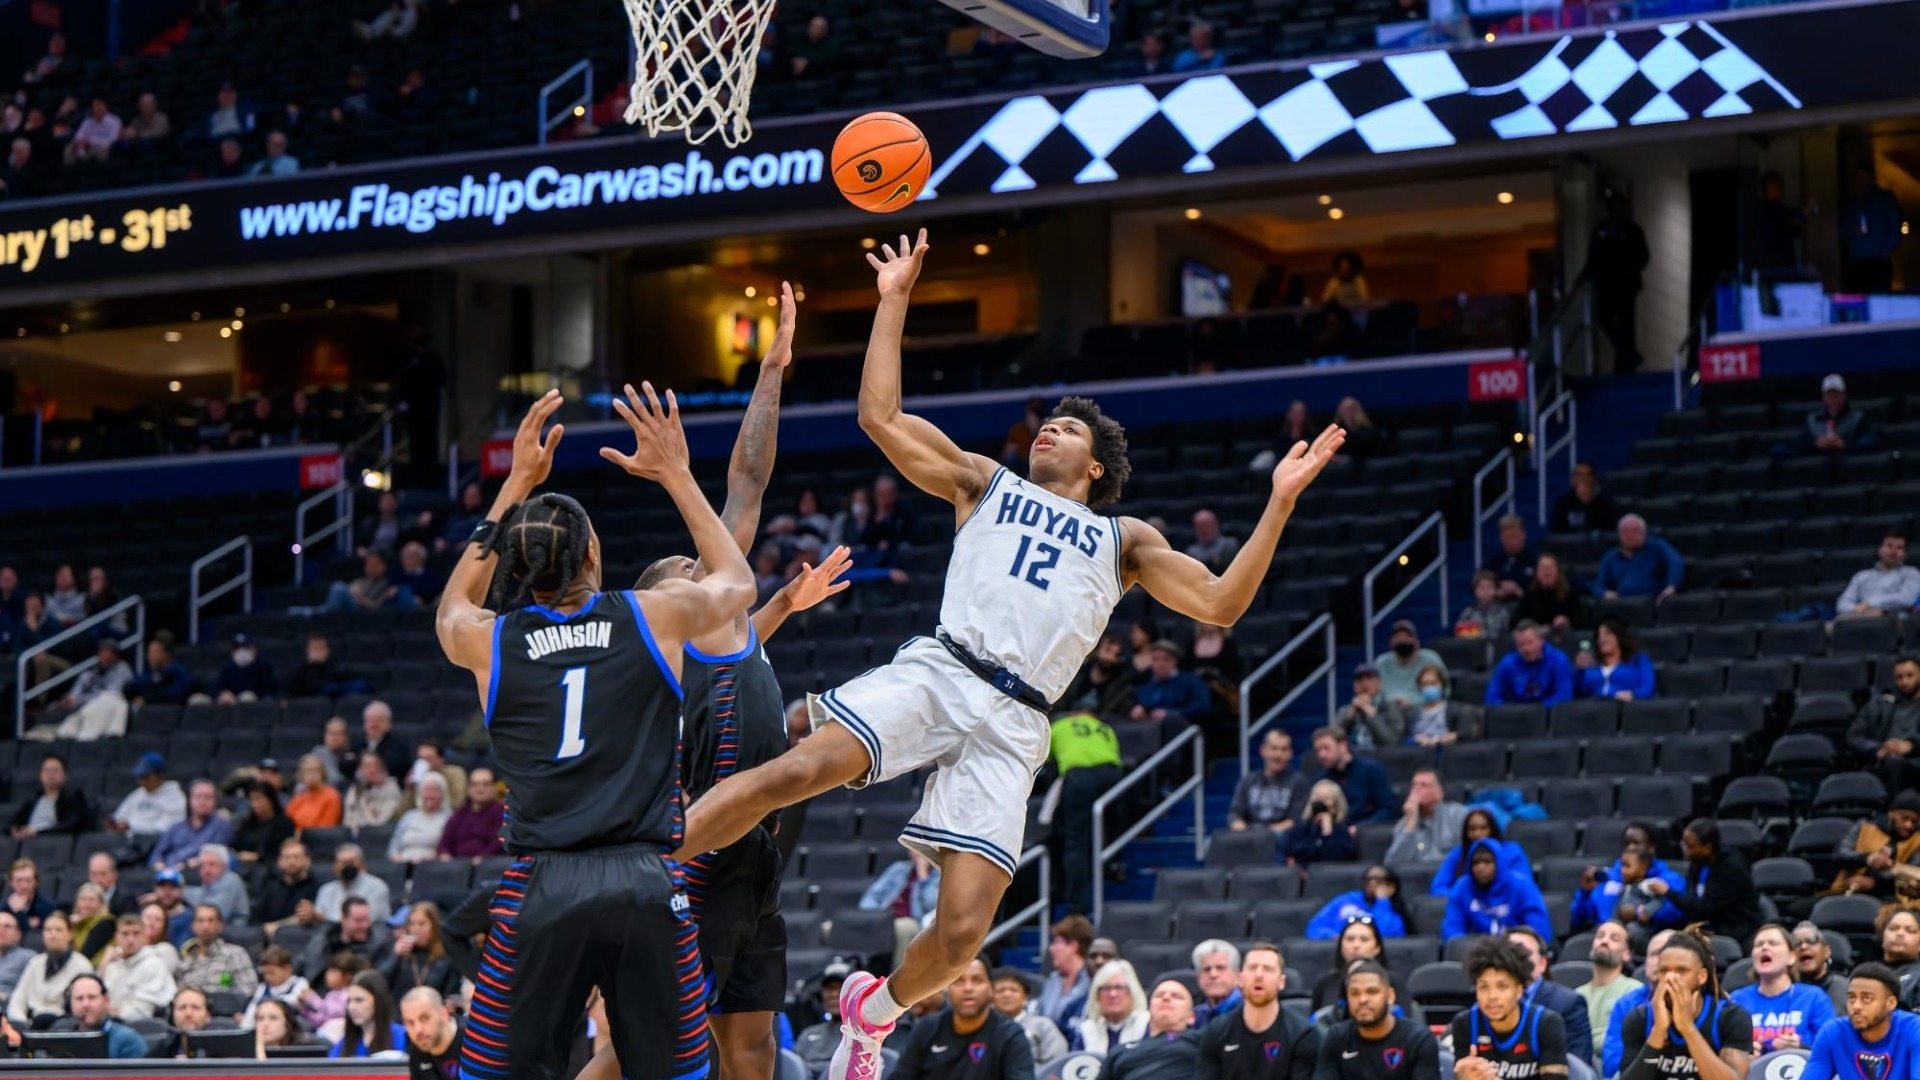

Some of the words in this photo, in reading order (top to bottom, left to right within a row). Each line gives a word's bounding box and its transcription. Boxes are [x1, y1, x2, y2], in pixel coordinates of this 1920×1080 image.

[240, 148, 824, 240] www.FlagshipCarwash.com
[0, 229, 47, 273] ry
[51, 214, 95, 259] 1st
[121, 203, 192, 252] 31st
[1478, 370, 1520, 394] 100
[1712, 352, 1748, 376] 121
[996, 492, 1104, 558] HOYAS
[1009, 534, 1062, 591] 12
[524, 621, 612, 661] JOHNSON
[554, 666, 587, 760] 1
